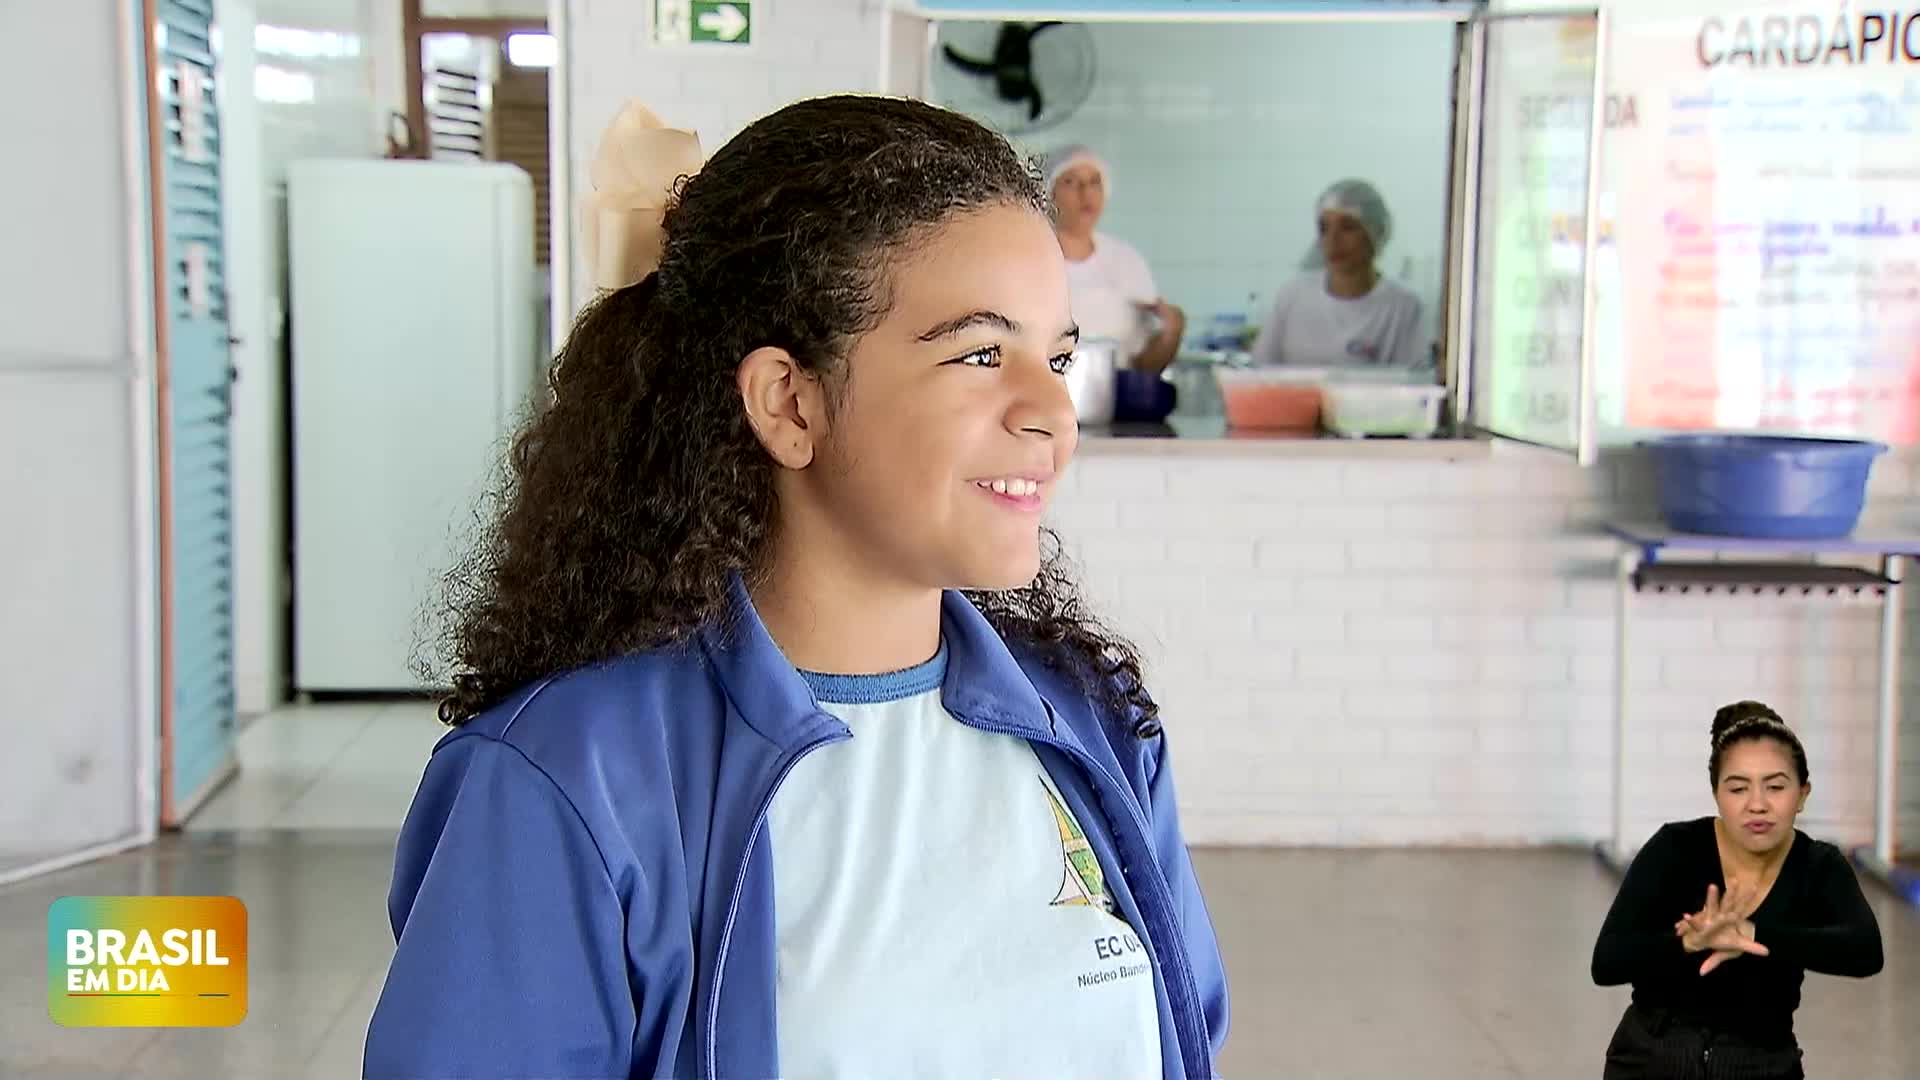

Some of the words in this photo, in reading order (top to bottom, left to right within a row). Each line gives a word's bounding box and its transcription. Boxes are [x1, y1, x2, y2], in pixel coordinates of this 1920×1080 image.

[1517, 93, 1641, 130] SEGUDA
[1094, 935, 1122, 960] EC
[1077, 970, 1117, 988] Núcleo
